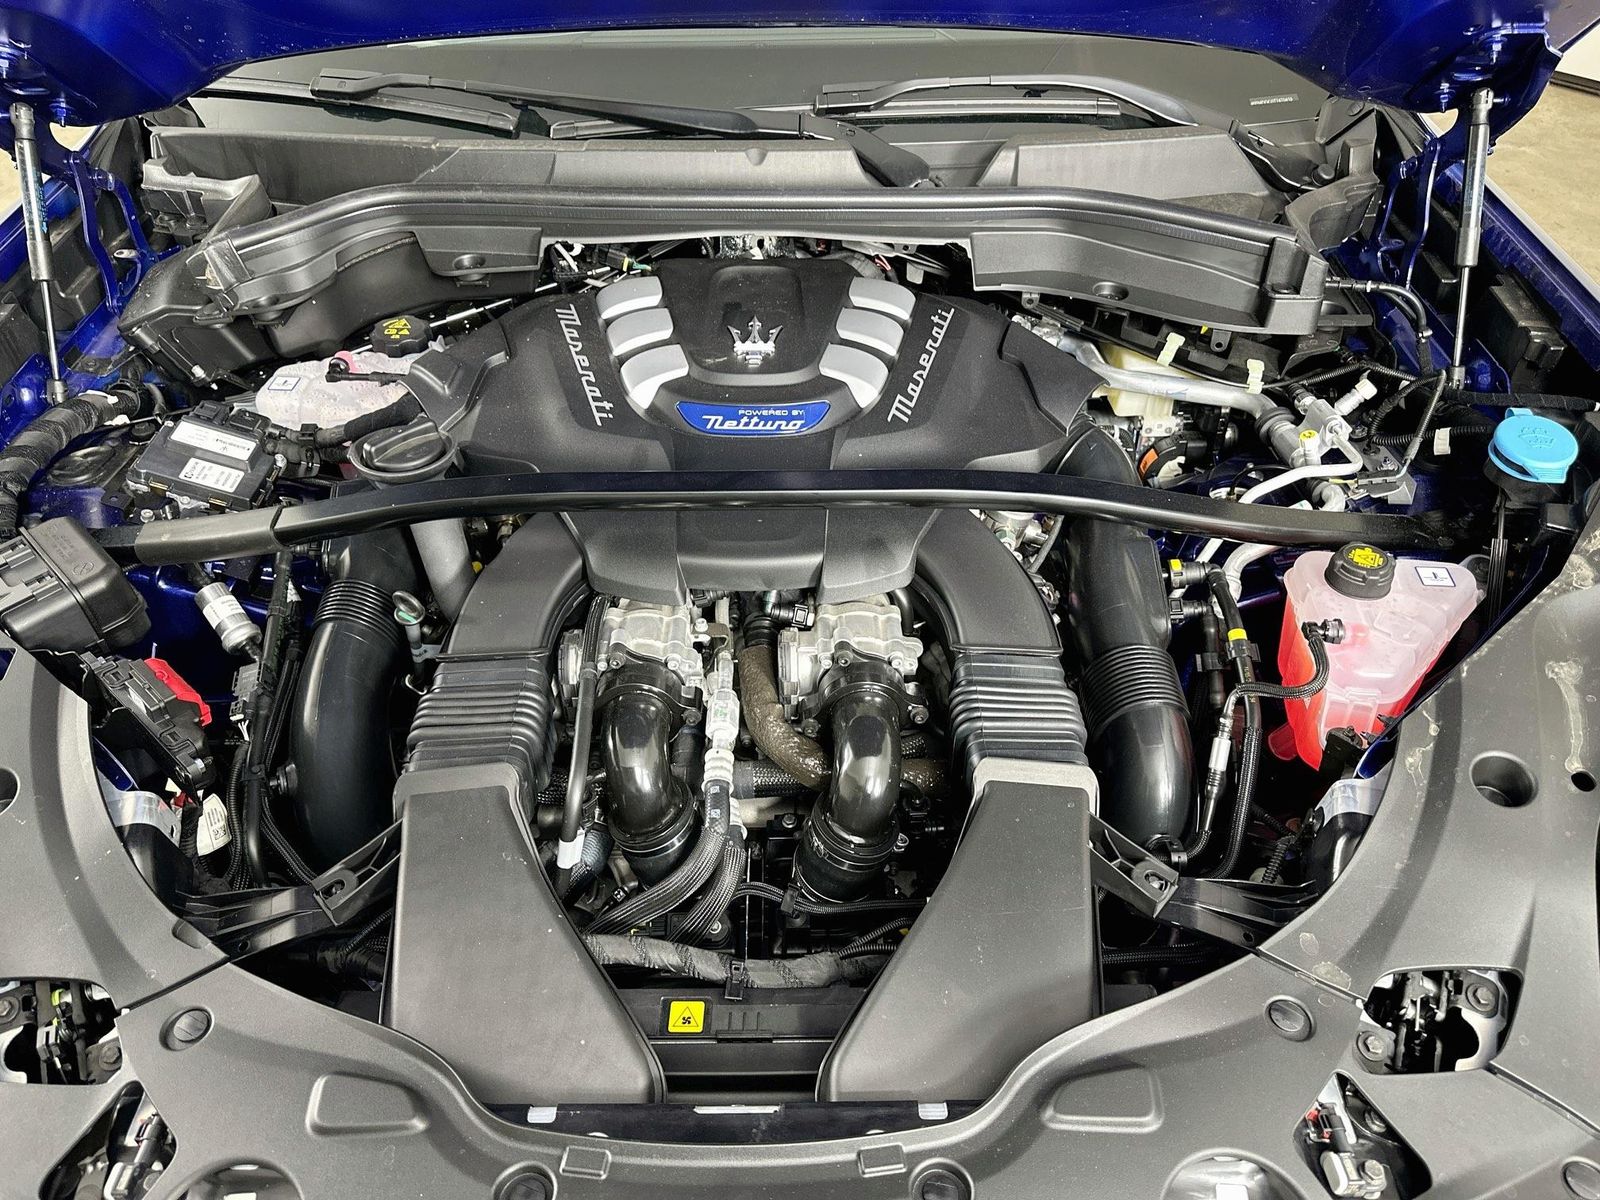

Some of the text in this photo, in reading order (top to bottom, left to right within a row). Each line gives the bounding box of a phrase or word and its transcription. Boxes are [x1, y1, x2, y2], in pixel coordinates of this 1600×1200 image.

[555, 303, 614, 426] Maserati
[887, 307, 955, 423] Maserati
[702, 416, 805, 430] Nettuno
